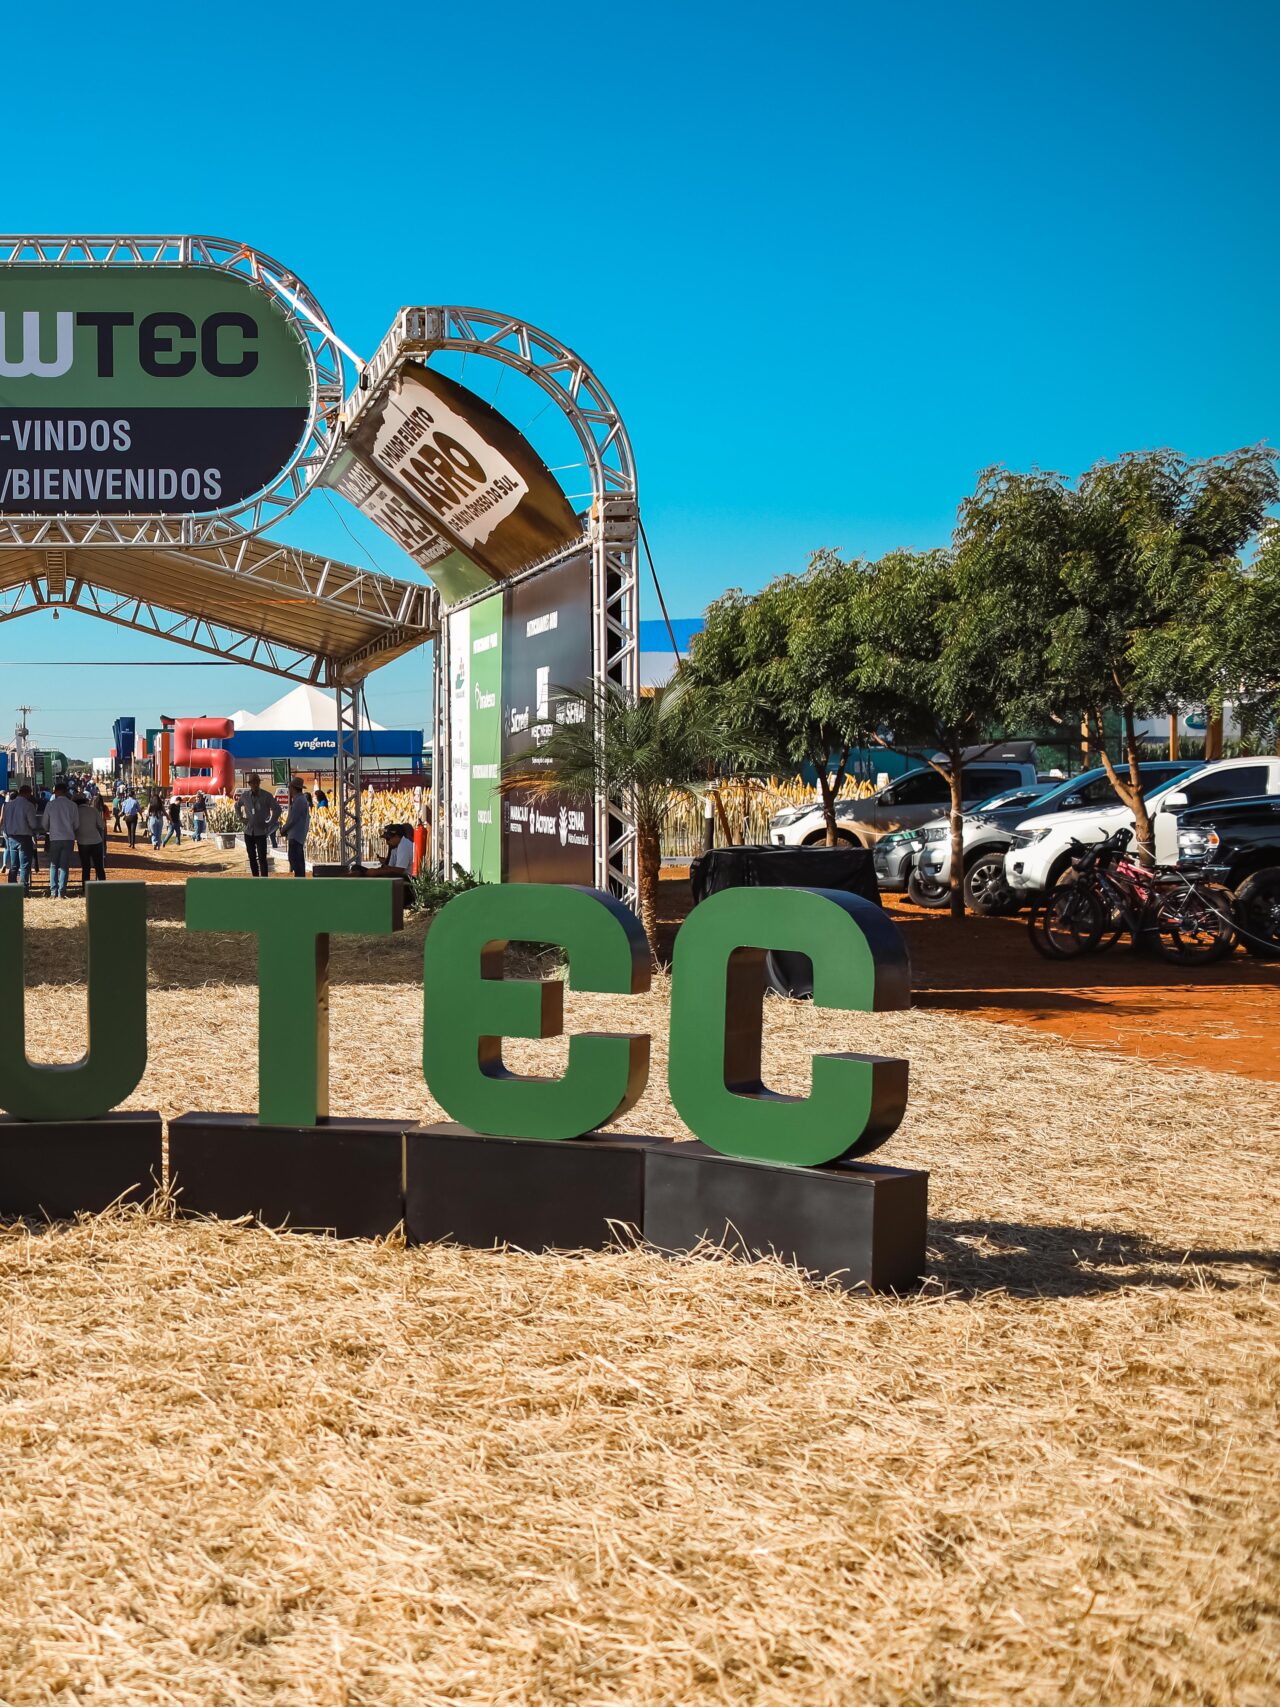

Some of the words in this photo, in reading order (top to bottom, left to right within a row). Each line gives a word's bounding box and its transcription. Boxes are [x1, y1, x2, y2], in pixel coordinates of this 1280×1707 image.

[397, 406, 435, 447] EVENTO
[399, 431, 487, 517] AGRO
[493, 475, 519, 496] SUL
[294, 739, 335, 750] syngenta
